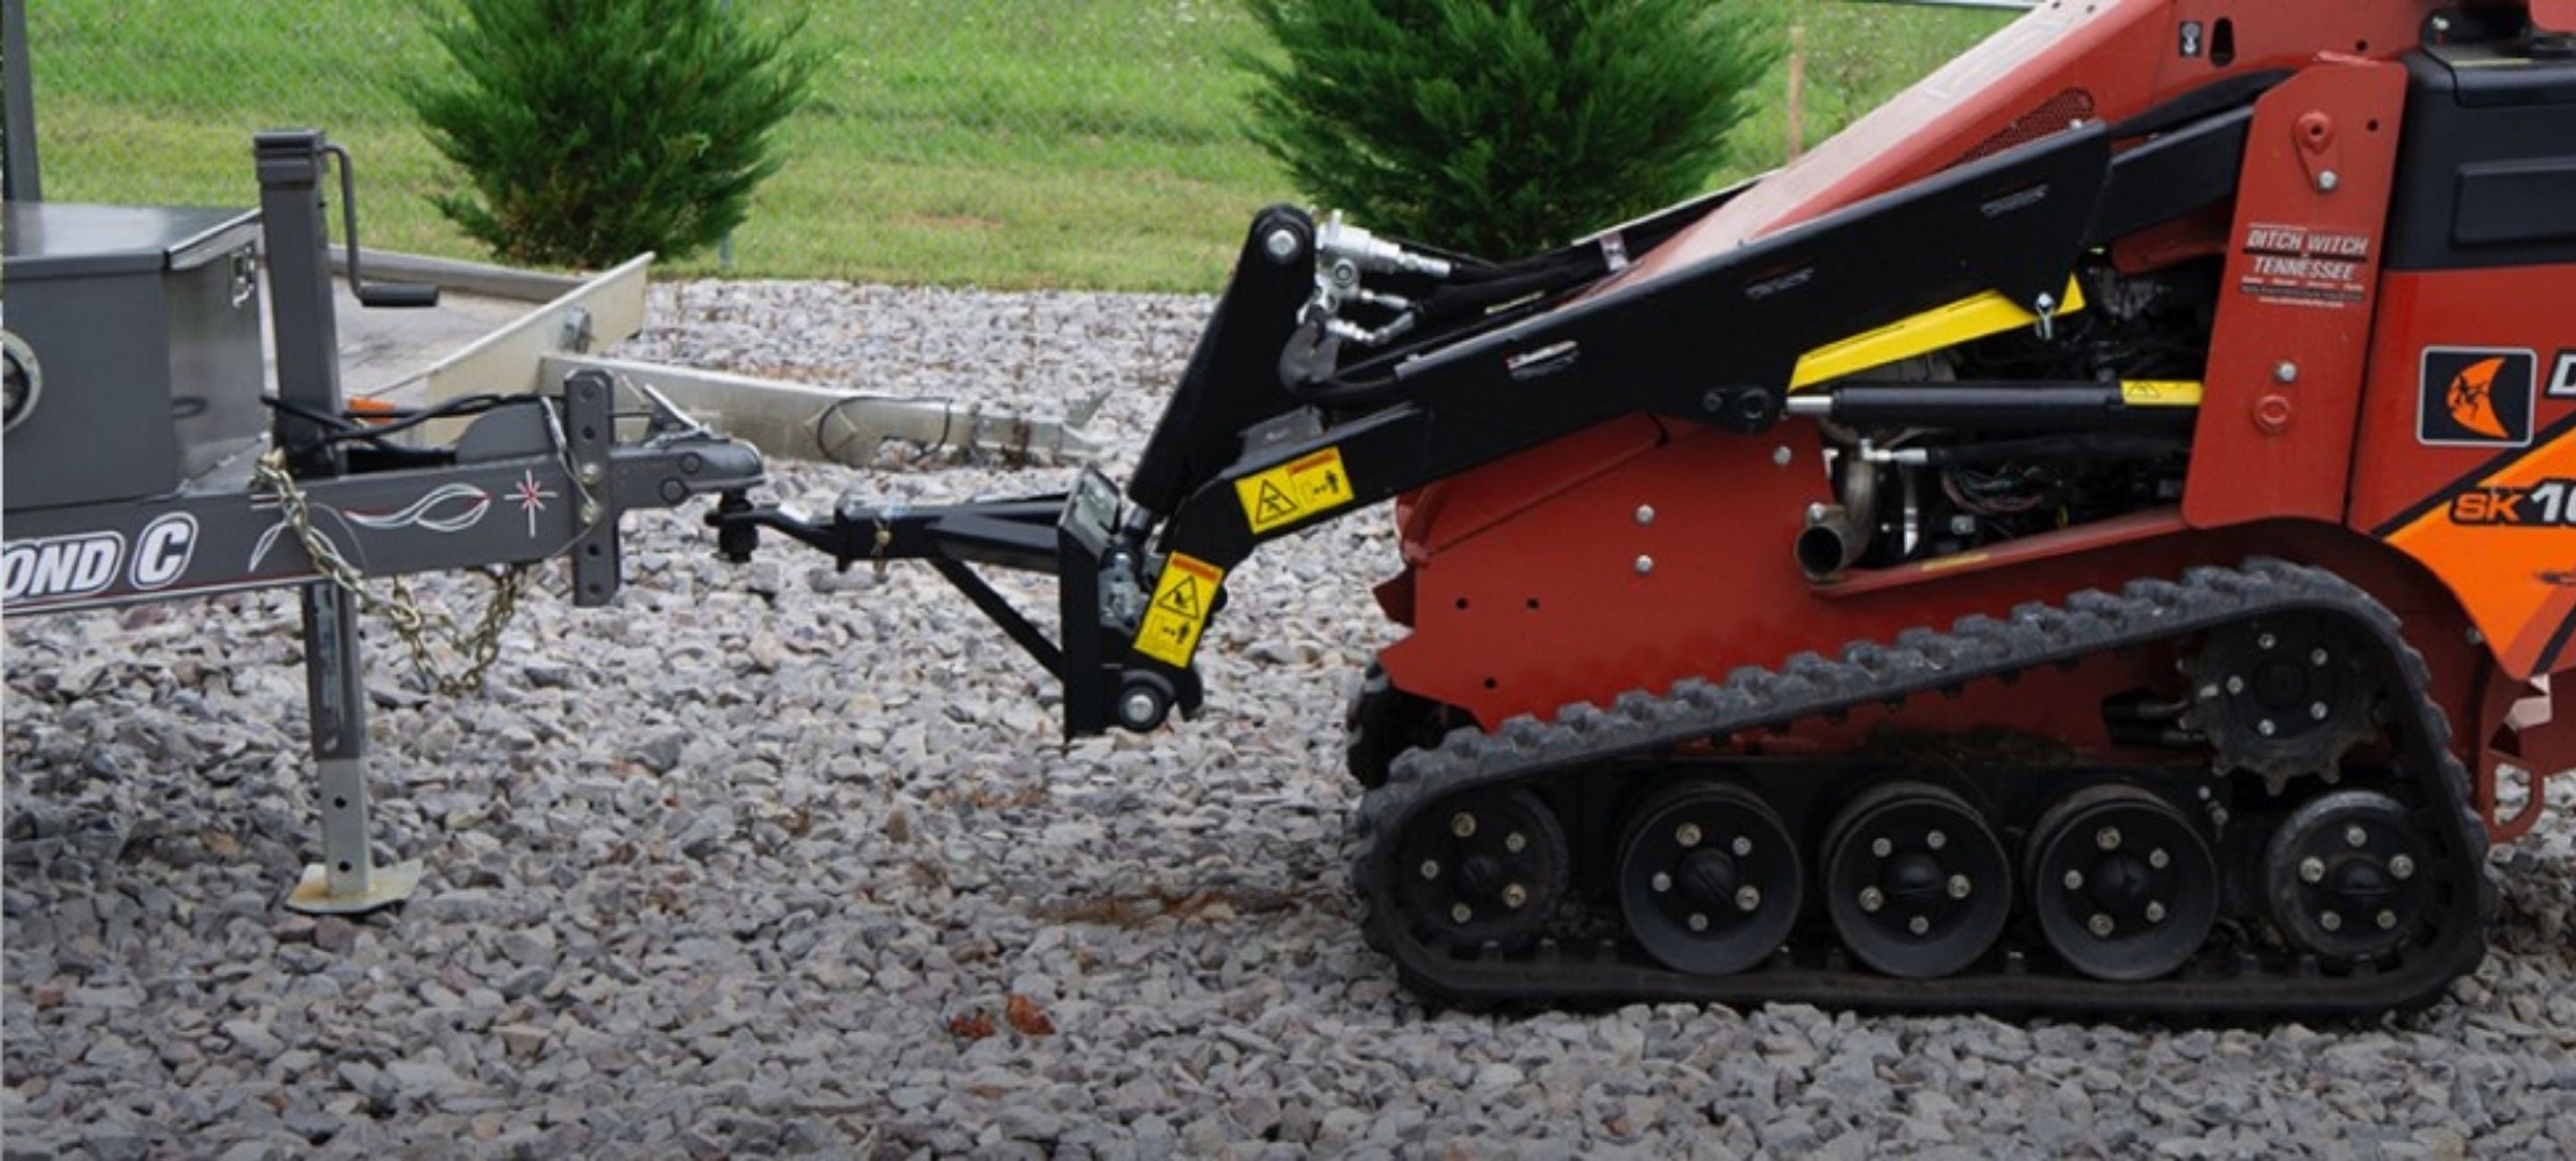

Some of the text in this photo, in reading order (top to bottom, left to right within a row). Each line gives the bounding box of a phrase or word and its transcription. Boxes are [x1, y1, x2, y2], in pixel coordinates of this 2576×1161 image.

[2246, 230, 2369, 255] DITCH WITCH
[2254, 256, 2355, 280] TENNESSEE
[136, 519, 193, 586] C
